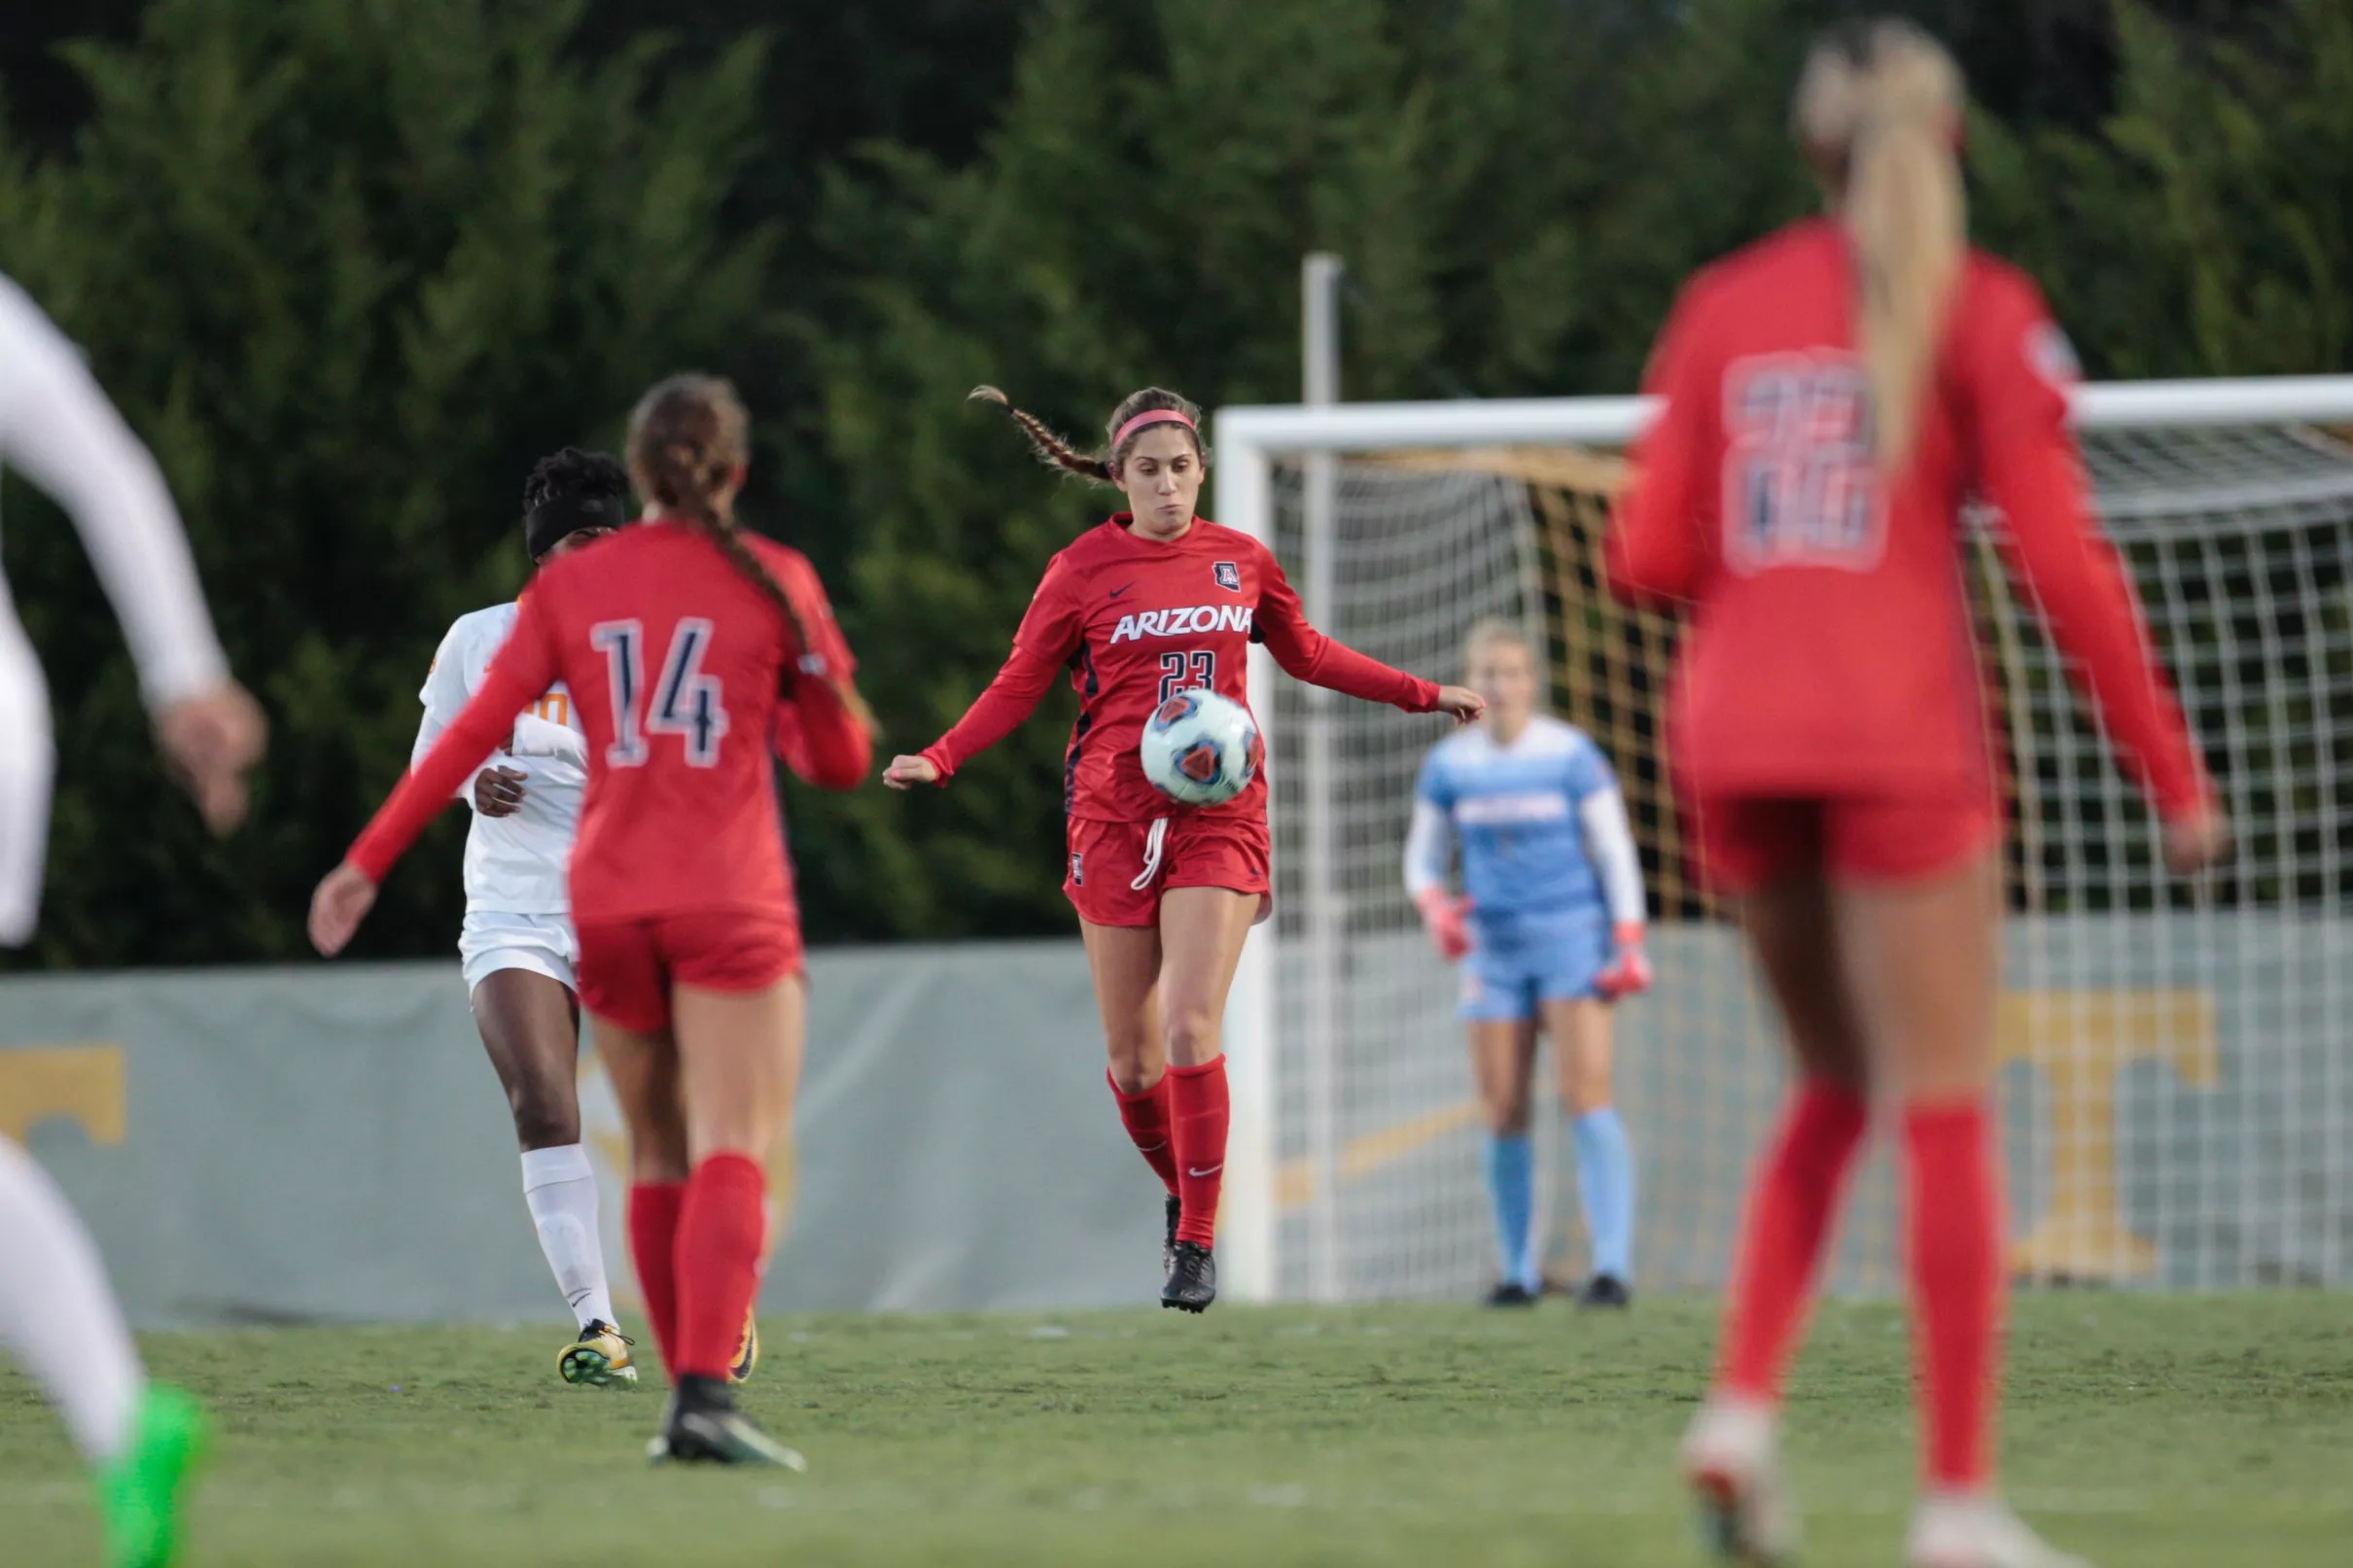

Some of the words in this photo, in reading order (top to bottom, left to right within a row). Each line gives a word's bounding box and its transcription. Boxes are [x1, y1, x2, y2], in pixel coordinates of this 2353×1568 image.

[1108, 605, 1253, 645] ARIZONA
[590, 616, 729, 768] 14
[1158, 650, 1215, 706] 23
